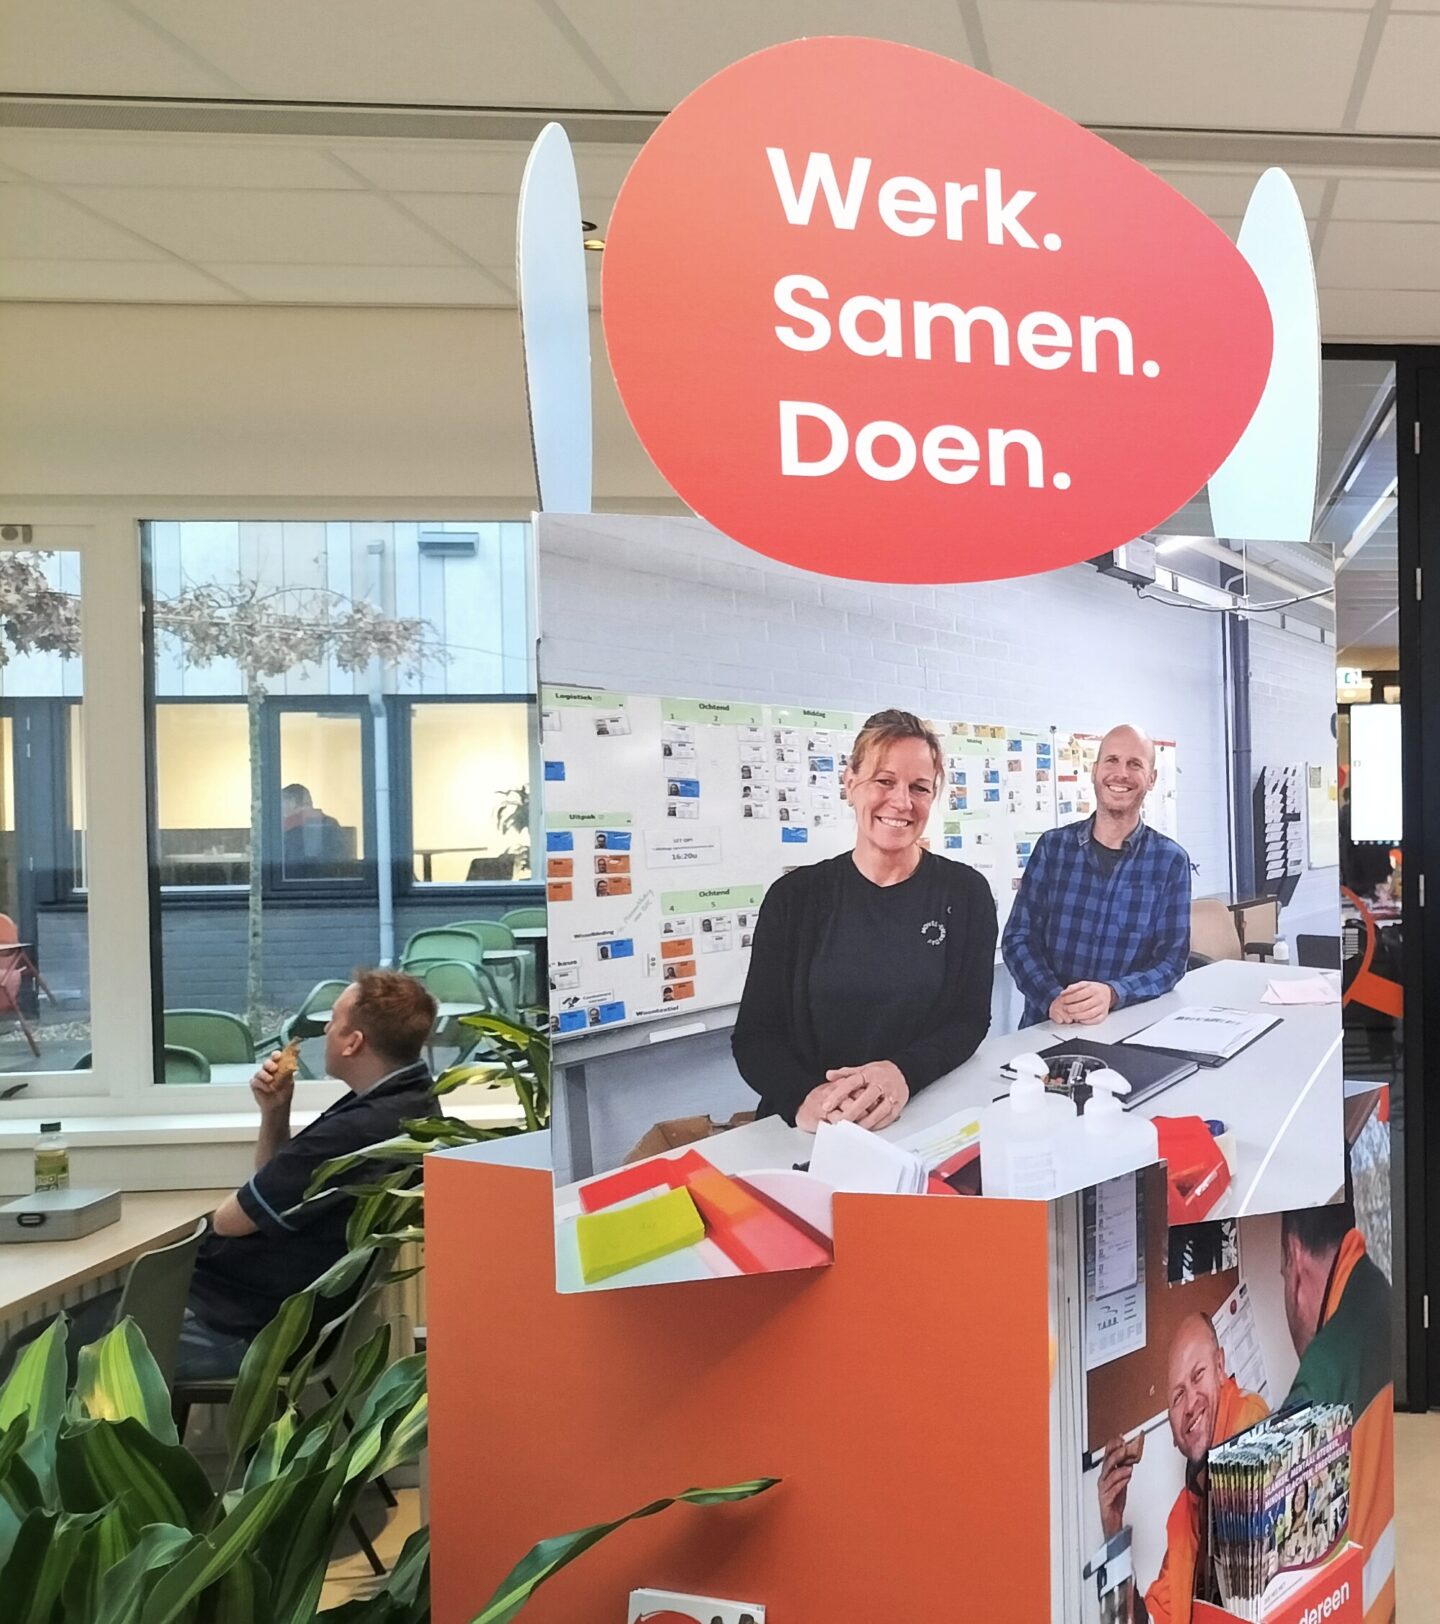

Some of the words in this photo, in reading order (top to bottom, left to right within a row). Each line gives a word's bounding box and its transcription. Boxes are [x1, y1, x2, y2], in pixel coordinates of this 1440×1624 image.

[765, 147, 1062, 252] Werk.
[773, 274, 1160, 378] Samen.
[779, 400, 1072, 490] Doen.
[698, 702, 730, 712] Ochtend
[698, 888, 730, 898] Ochtend
